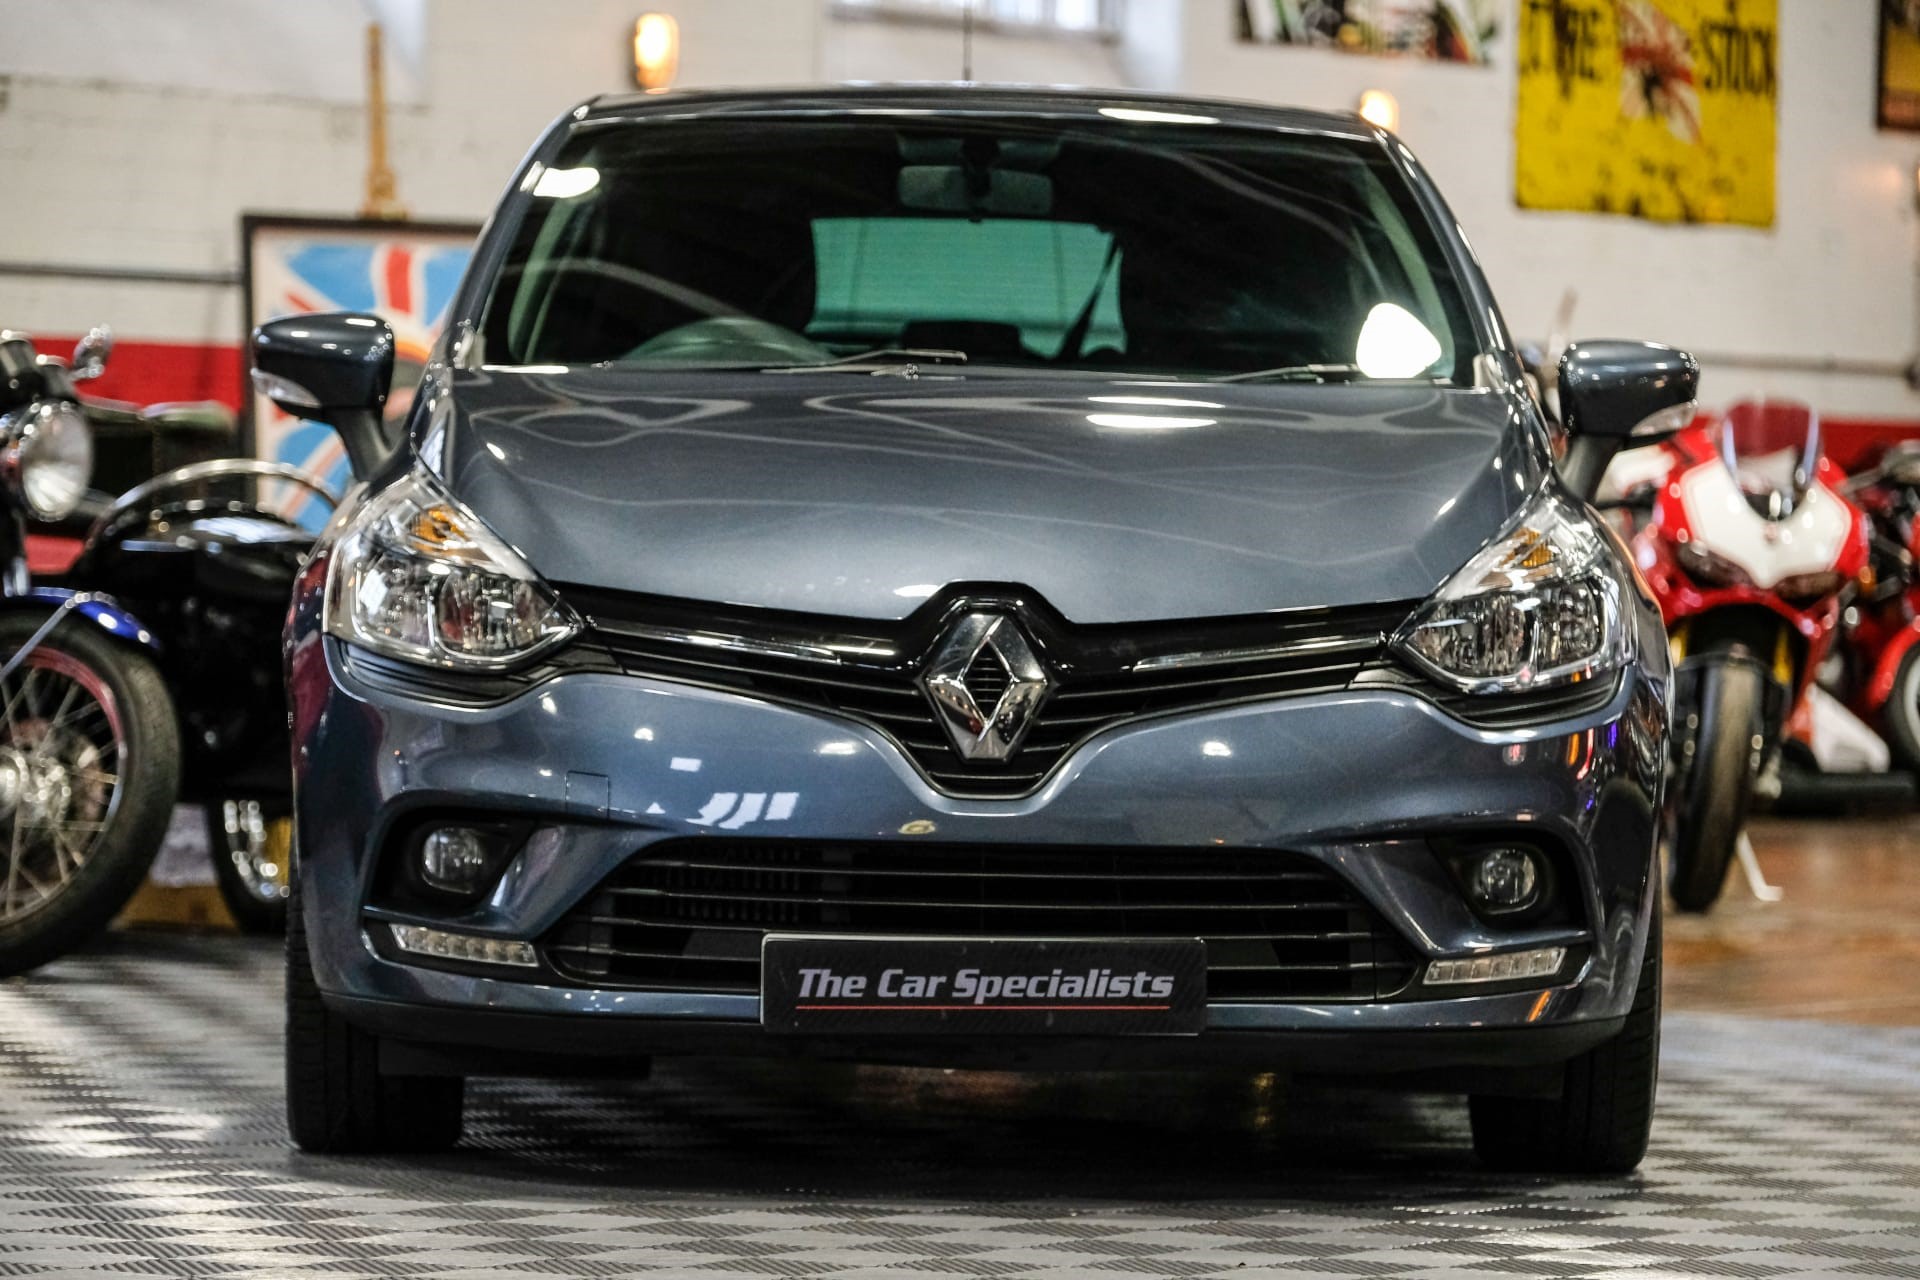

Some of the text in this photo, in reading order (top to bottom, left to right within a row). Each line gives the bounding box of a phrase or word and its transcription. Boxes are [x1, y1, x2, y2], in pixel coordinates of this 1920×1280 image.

[797, 968, 1175, 1005] The Car Specialists
